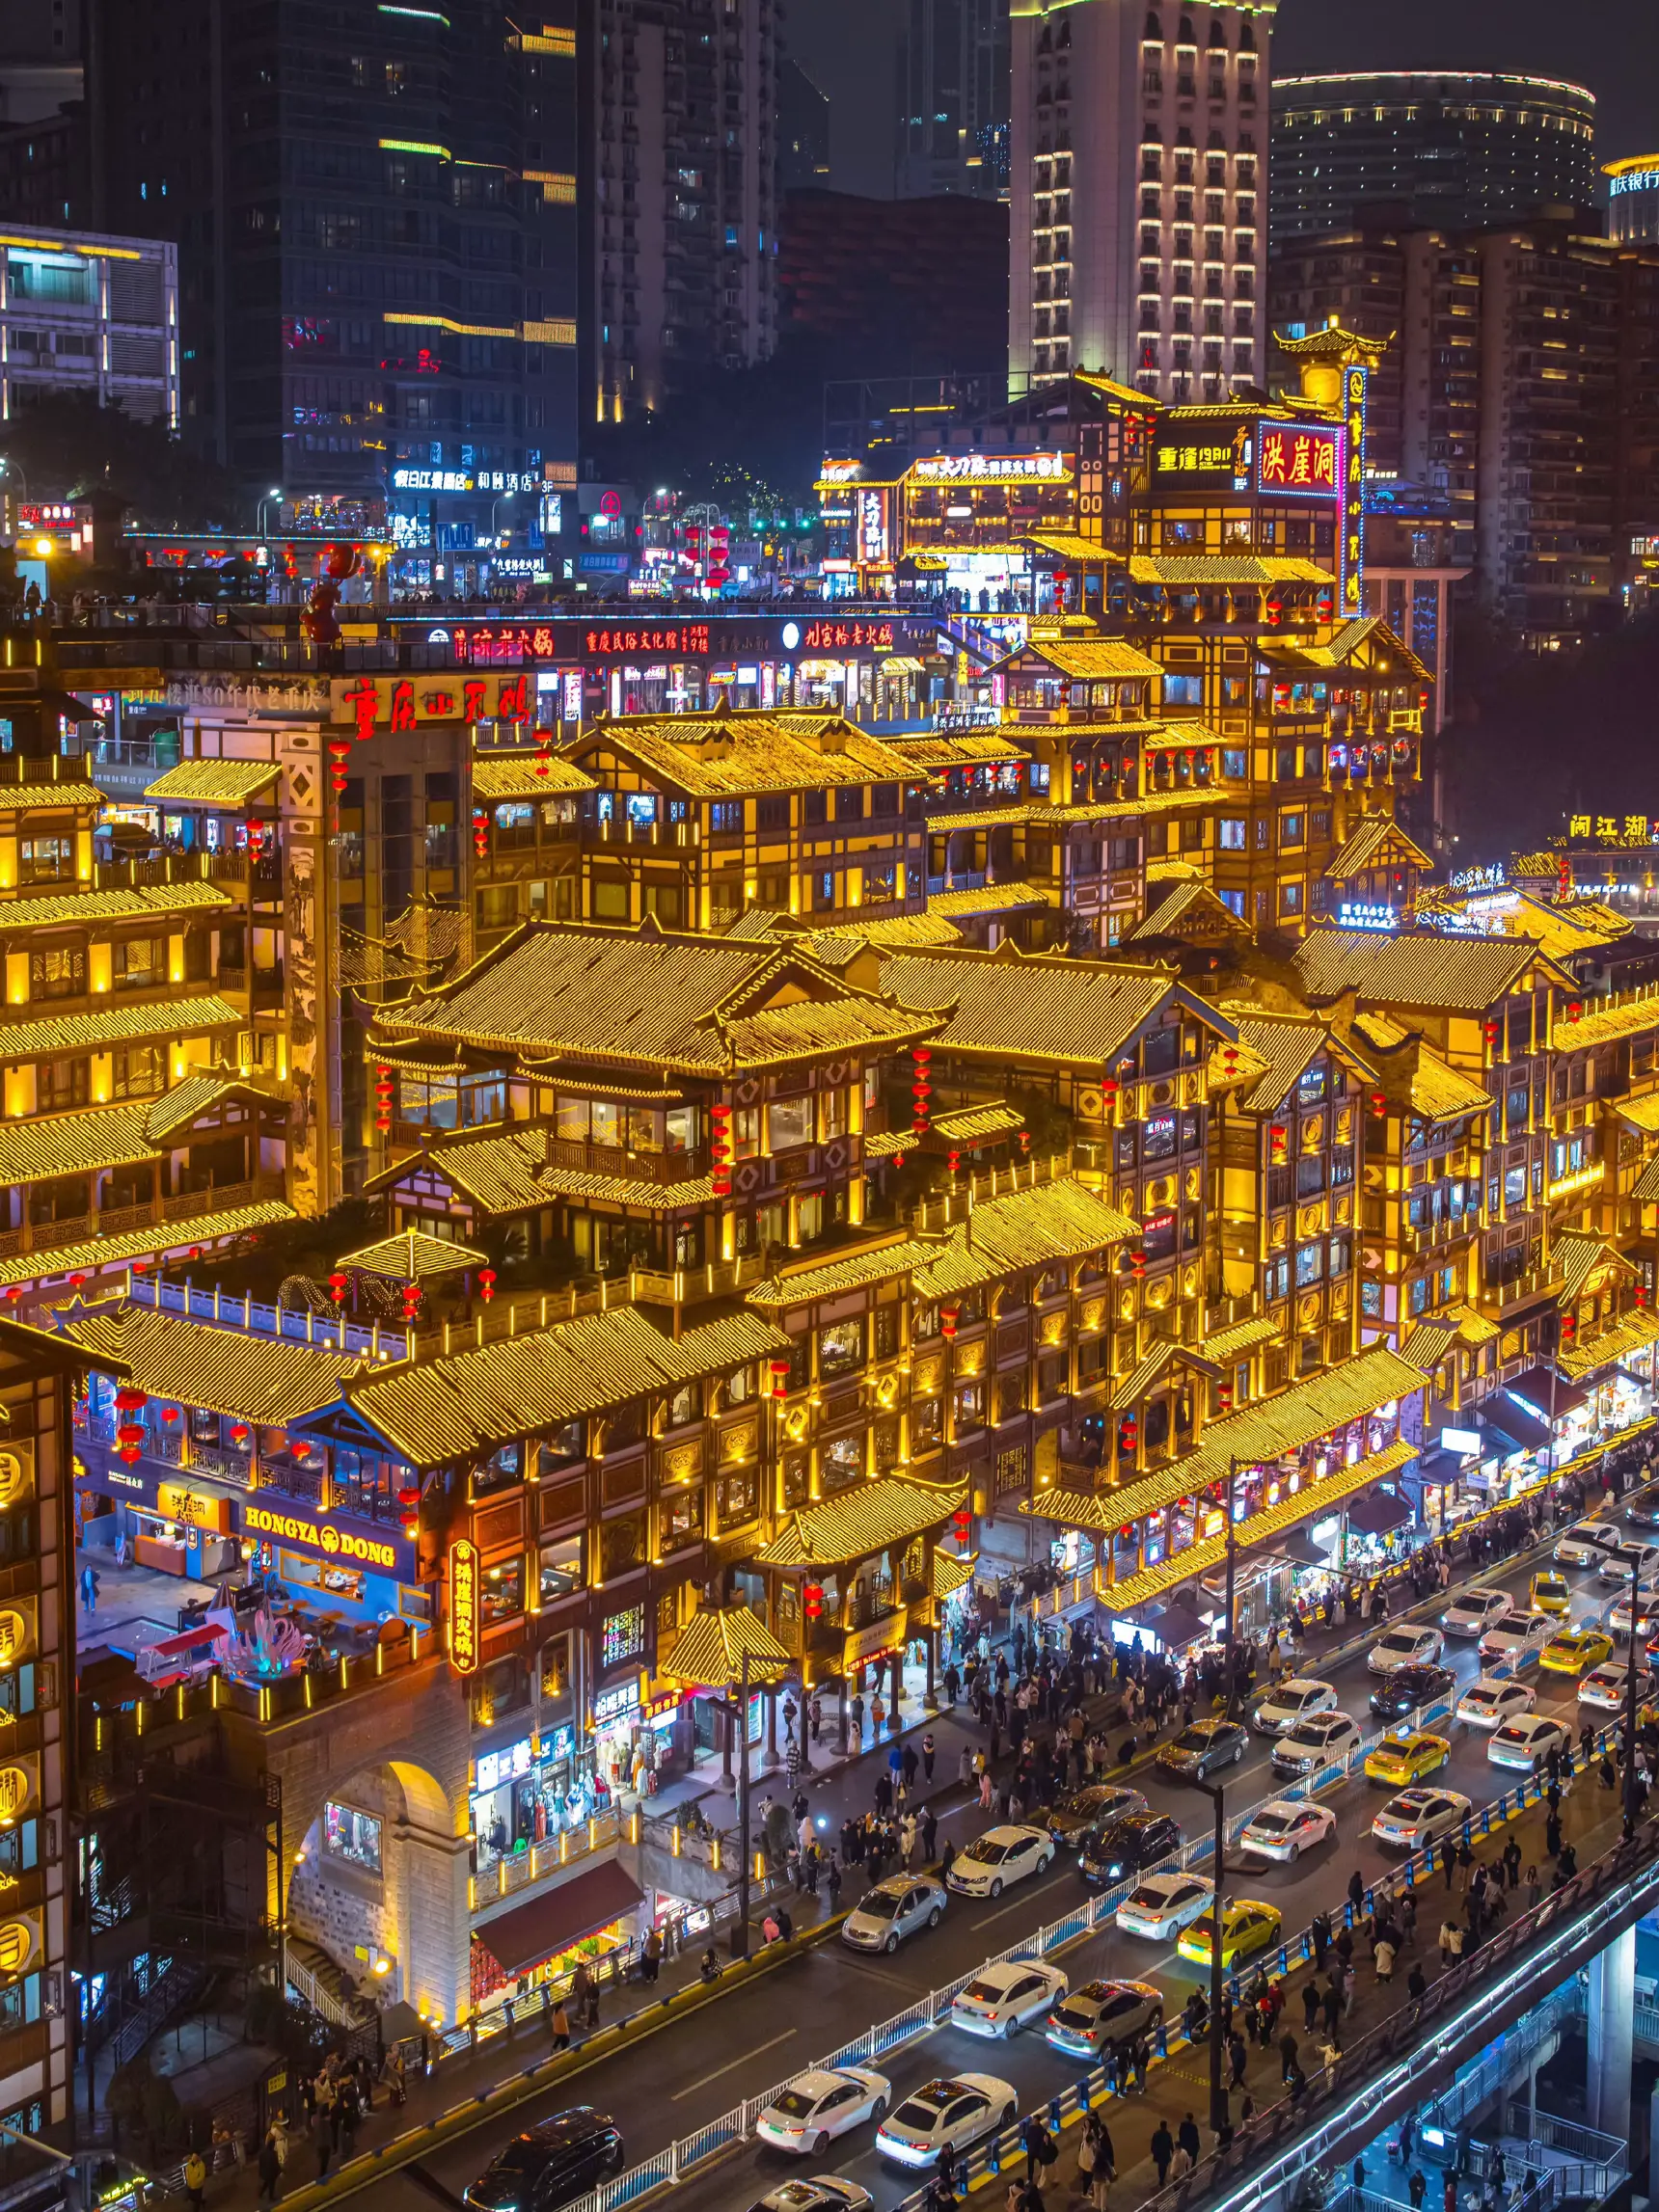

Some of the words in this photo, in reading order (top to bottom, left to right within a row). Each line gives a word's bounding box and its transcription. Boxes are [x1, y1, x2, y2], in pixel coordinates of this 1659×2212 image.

[1263, 432, 1334, 485] 洪崖洞
[477, 472, 532, 492] 和颐酒店
[541, 482, 553, 493] 3F
[1570, 815, 1647, 837] 闹江湖
[246, 1506, 320, 1547] HONGYA
[340, 1533, 395, 1568] DONG
[454, 1562, 473, 1657] 洪崖洞火锅
